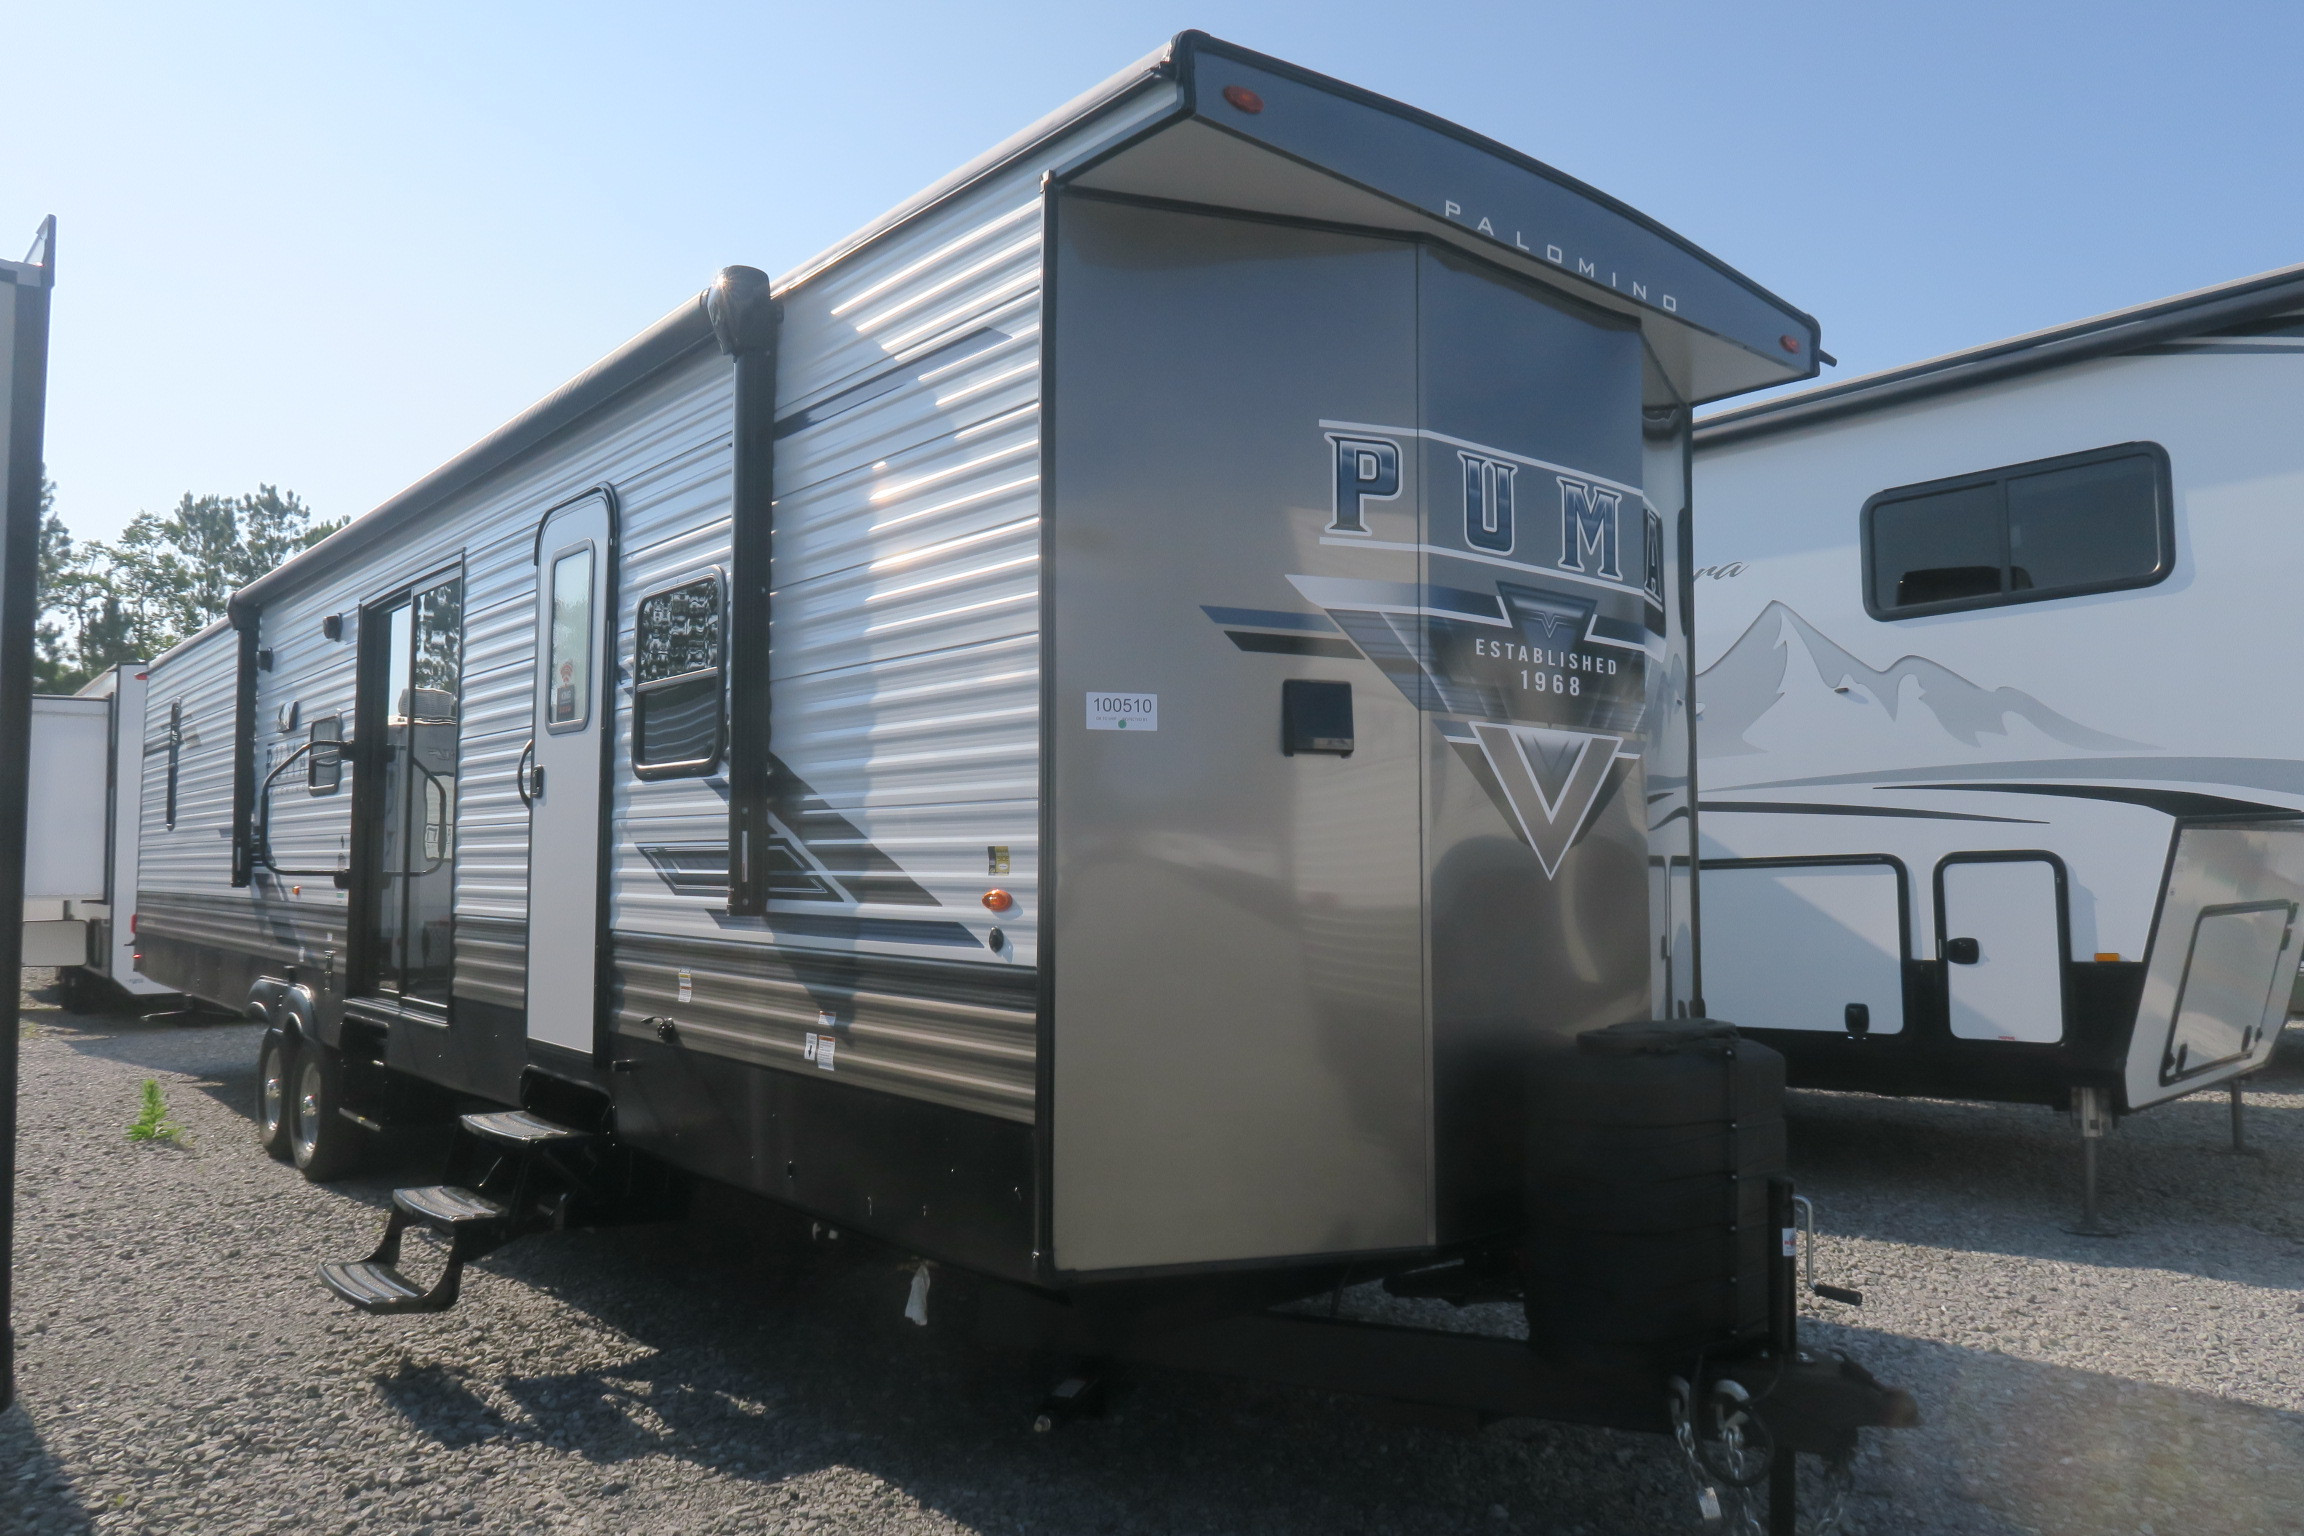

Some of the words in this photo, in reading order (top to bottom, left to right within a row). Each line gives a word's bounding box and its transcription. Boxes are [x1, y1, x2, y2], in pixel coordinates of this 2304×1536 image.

[1445, 200, 1677, 312] PALOMINO
[1324, 431, 1663, 603] PUMA
[1475, 638, 1617, 675] ESTABLISHED
[1520, 669, 1580, 696] 1968
[1093, 697, 1152, 713] 100510
